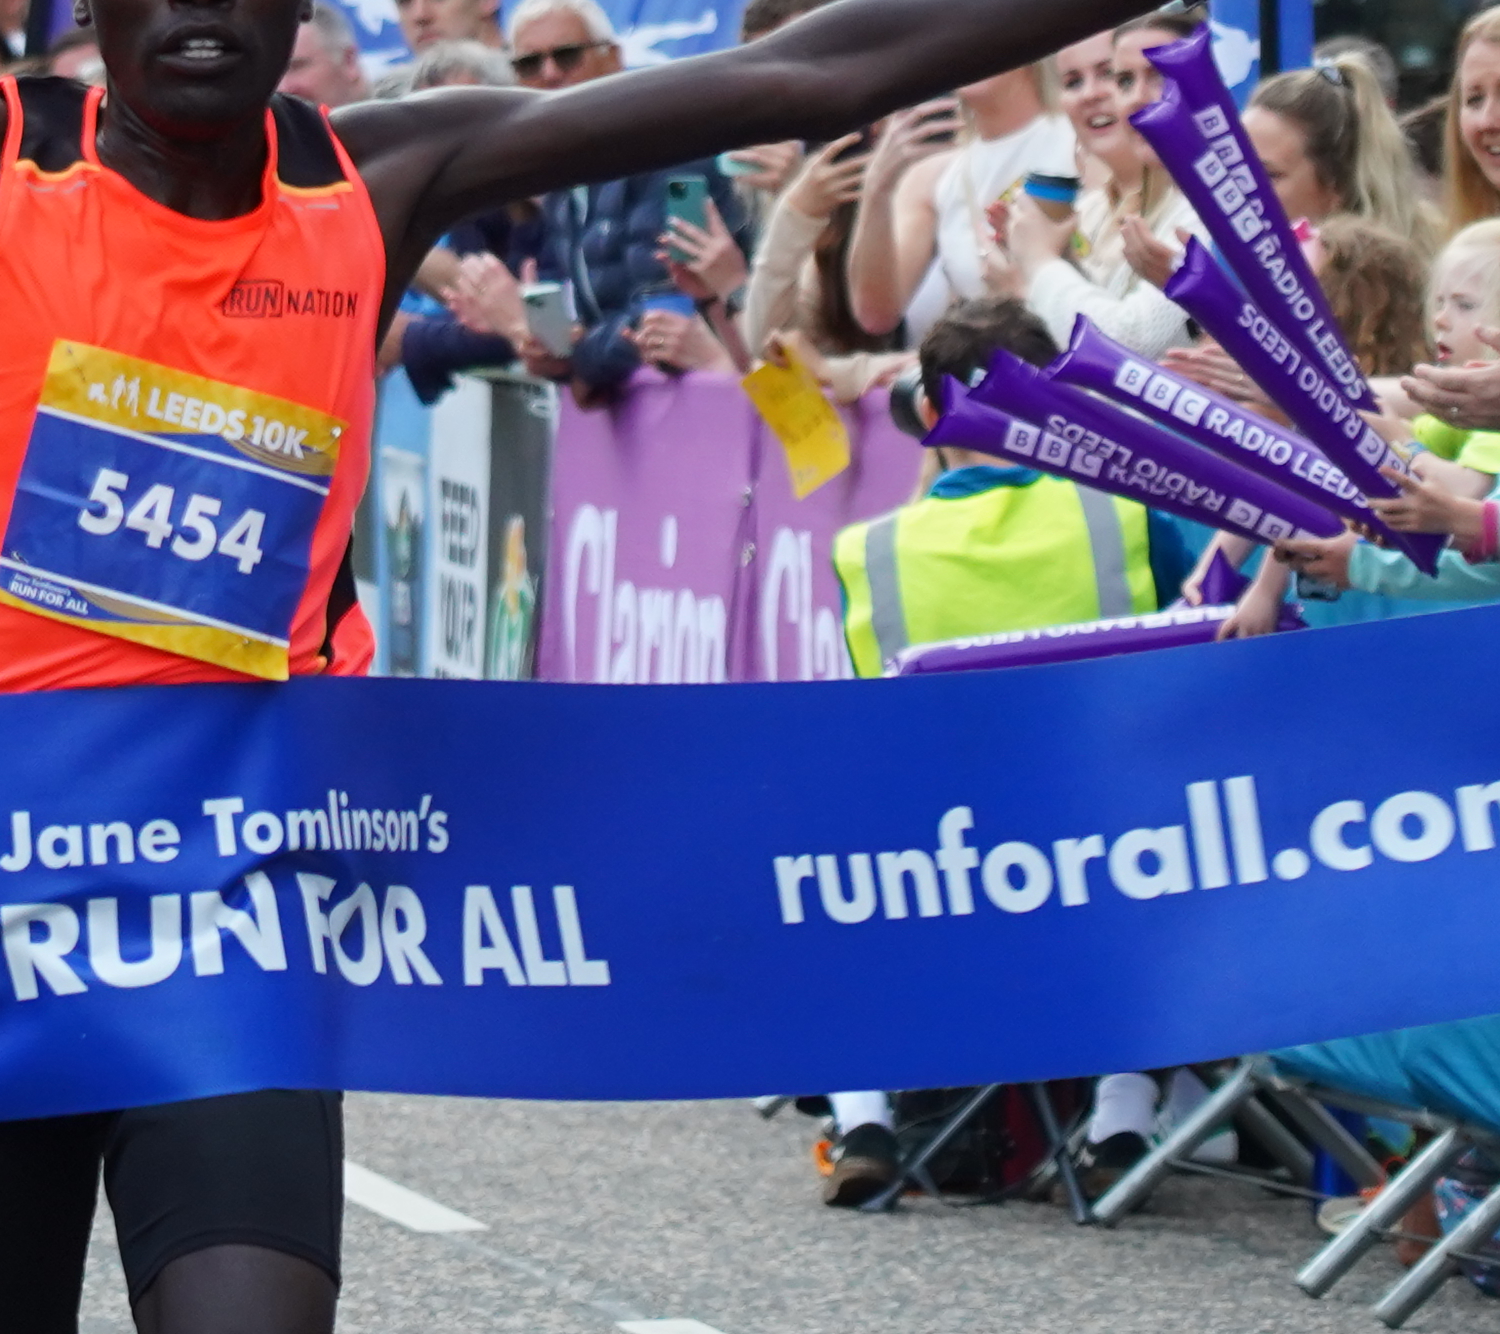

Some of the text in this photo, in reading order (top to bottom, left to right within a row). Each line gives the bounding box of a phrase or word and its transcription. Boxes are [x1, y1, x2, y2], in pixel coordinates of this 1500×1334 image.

[229, 286, 358, 320] RUN NATION
[1194, 149, 1368, 402] BBC RADIO LEEDS
[1237, 302, 1363, 441] RADIO LEEDS
[146, 387, 310, 460] LEEDS 10K
[1047, 414, 1133, 469] LEEDS
[1114, 359, 1211, 427] BBC
[1204, 407, 1293, 466] RADIO
[78, 467, 266, 575] 5454
[1134, 457, 1226, 513] RADIO
[9, 581, 89, 616] RUN FOR ALL
[202, 789, 450, 859] Tomlinson's
[296, 870, 442, 987] FOR
[462, 884, 611, 987] ALL
